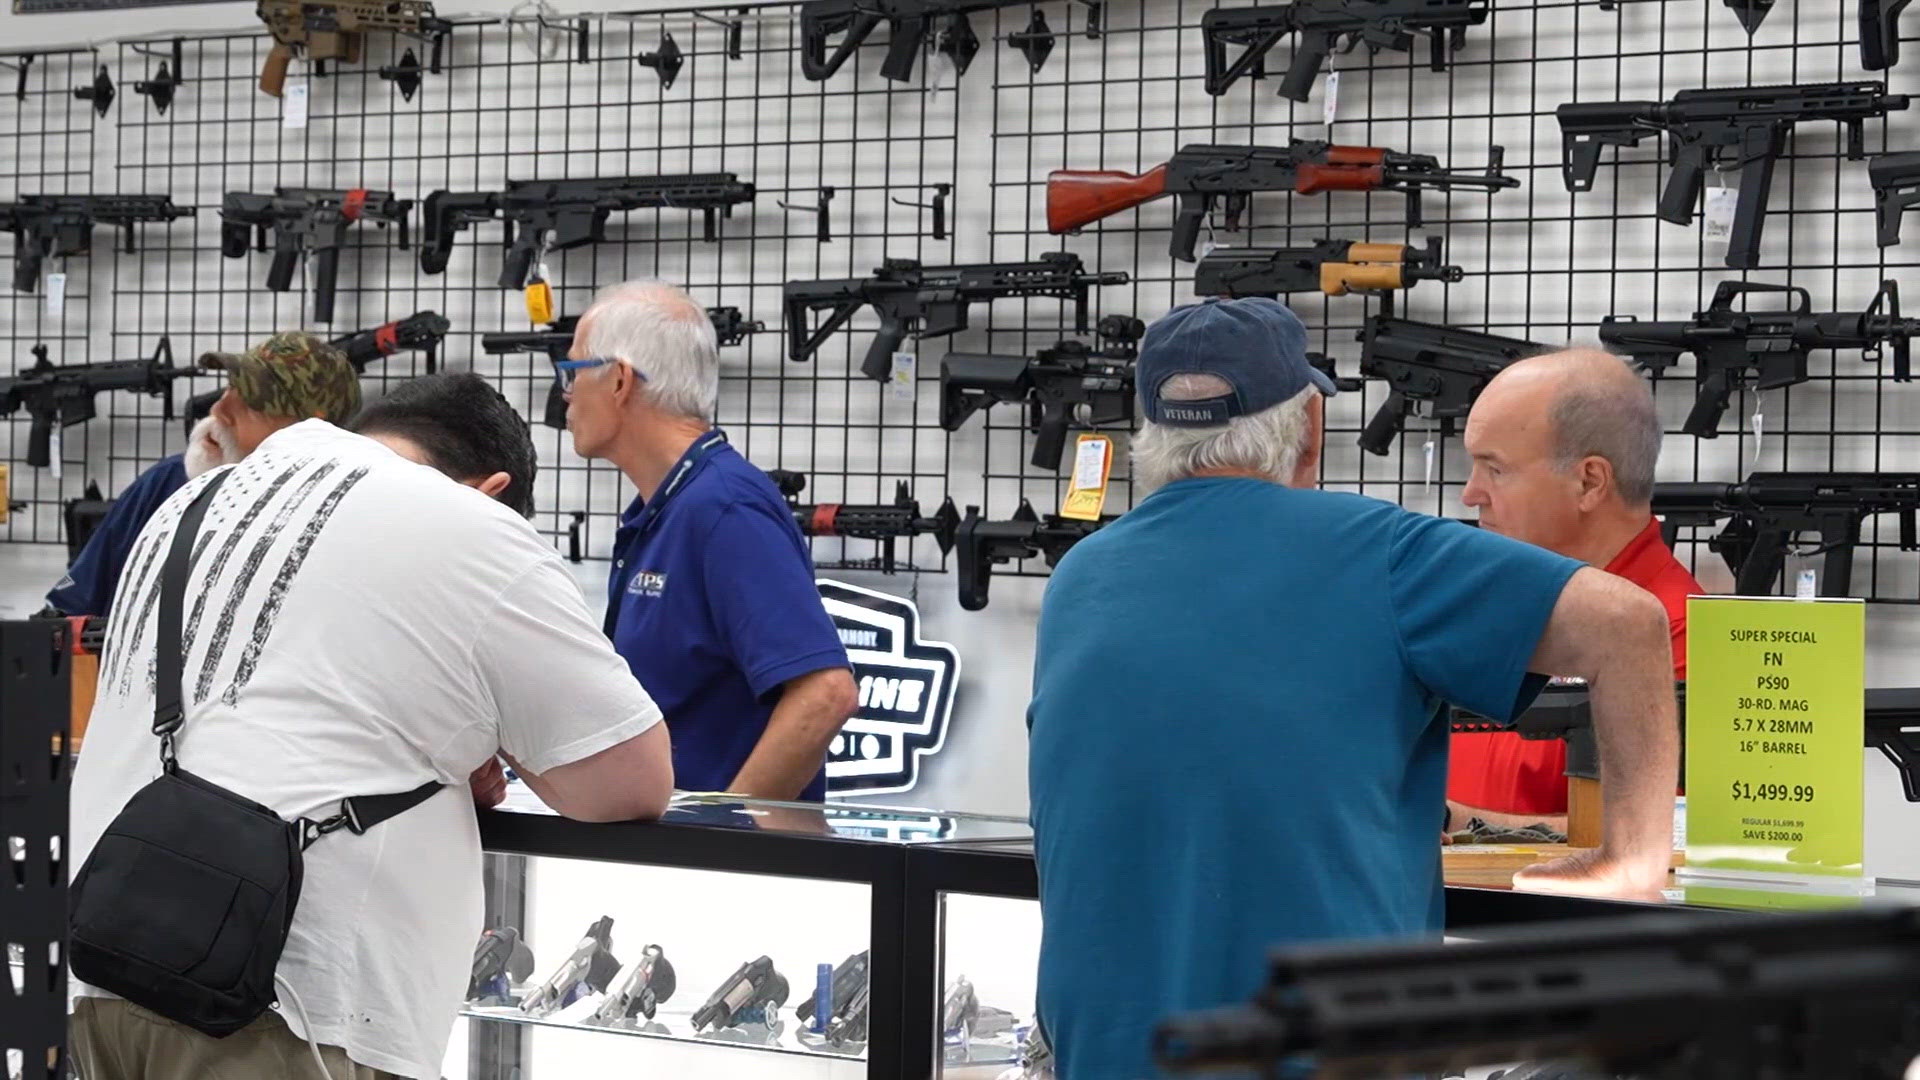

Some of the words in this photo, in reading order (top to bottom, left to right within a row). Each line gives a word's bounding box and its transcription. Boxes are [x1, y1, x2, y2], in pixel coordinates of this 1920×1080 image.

[1163, 407, 1212, 421] VETERAN
[1729, 629, 1768, 643] SUPER
[1770, 630, 1818, 644] SPECIAL
[1763, 652, 1783, 667] FN
[1757, 675, 1790, 690] PS90
[1737, 697, 1776, 711] 30-RD.
[1779, 698, 1809, 712] MAG
[1733, 717, 1753, 732] 5.7
[1756, 719, 1766, 733] X
[1769, 719, 1813, 735] 28MM
[1762, 741, 1808, 755] BARREL
[1732, 780, 1814, 802] $1,499.99
[1742, 817, 1772, 826] REGULAR
[1742, 829, 1766, 840] SAVE
[1767, 830, 1804, 842] $200.00
